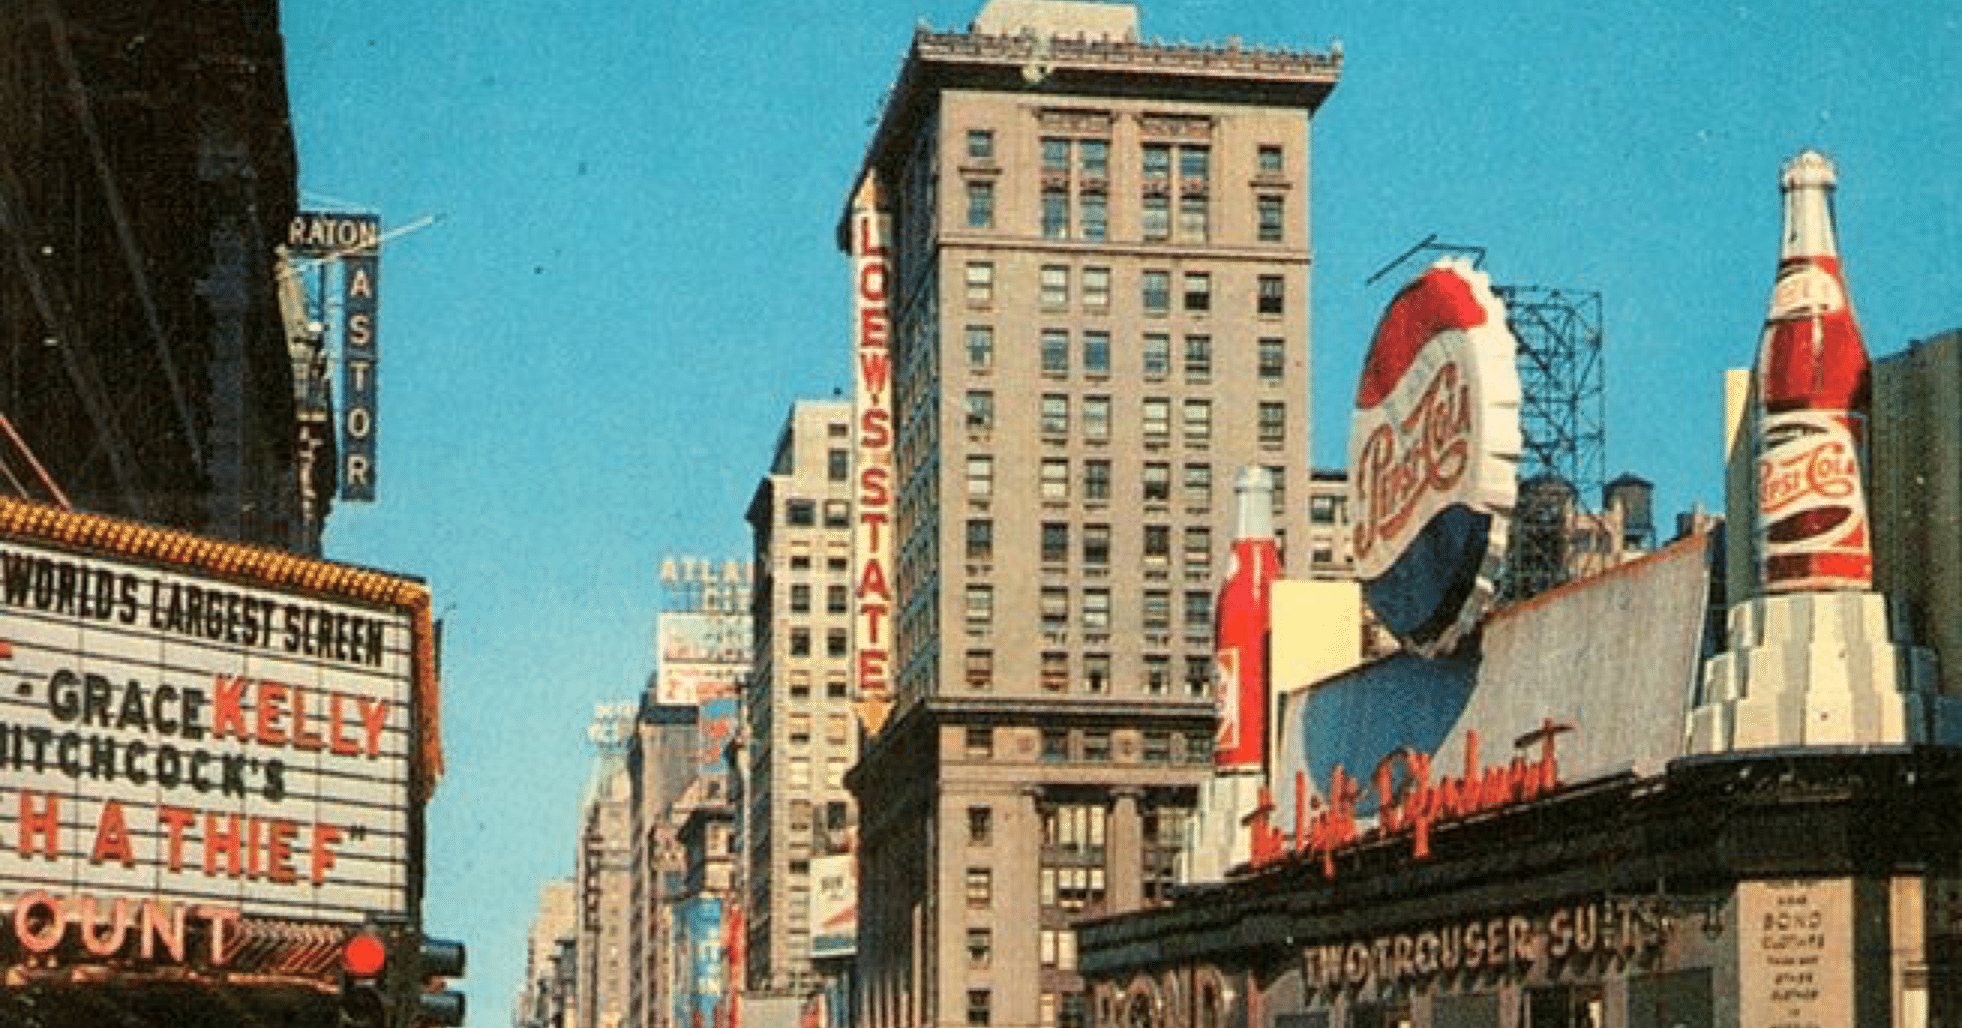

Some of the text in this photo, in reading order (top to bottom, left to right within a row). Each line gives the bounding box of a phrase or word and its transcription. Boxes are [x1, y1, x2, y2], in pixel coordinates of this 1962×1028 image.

[345, 269, 372, 486] ASTOR
[856, 215, 891, 692] LOEW'S STATE
[150, 578, 273, 650] LARGEST
[285, 603, 384, 668] SCREEN
[48, 668, 390, 760] GRACE KELLY
[0, 722, 286, 802] ITCHCOCK'S
[89, 798, 135, 868] A
[1374, 915, 1538, 977] TROUSER
